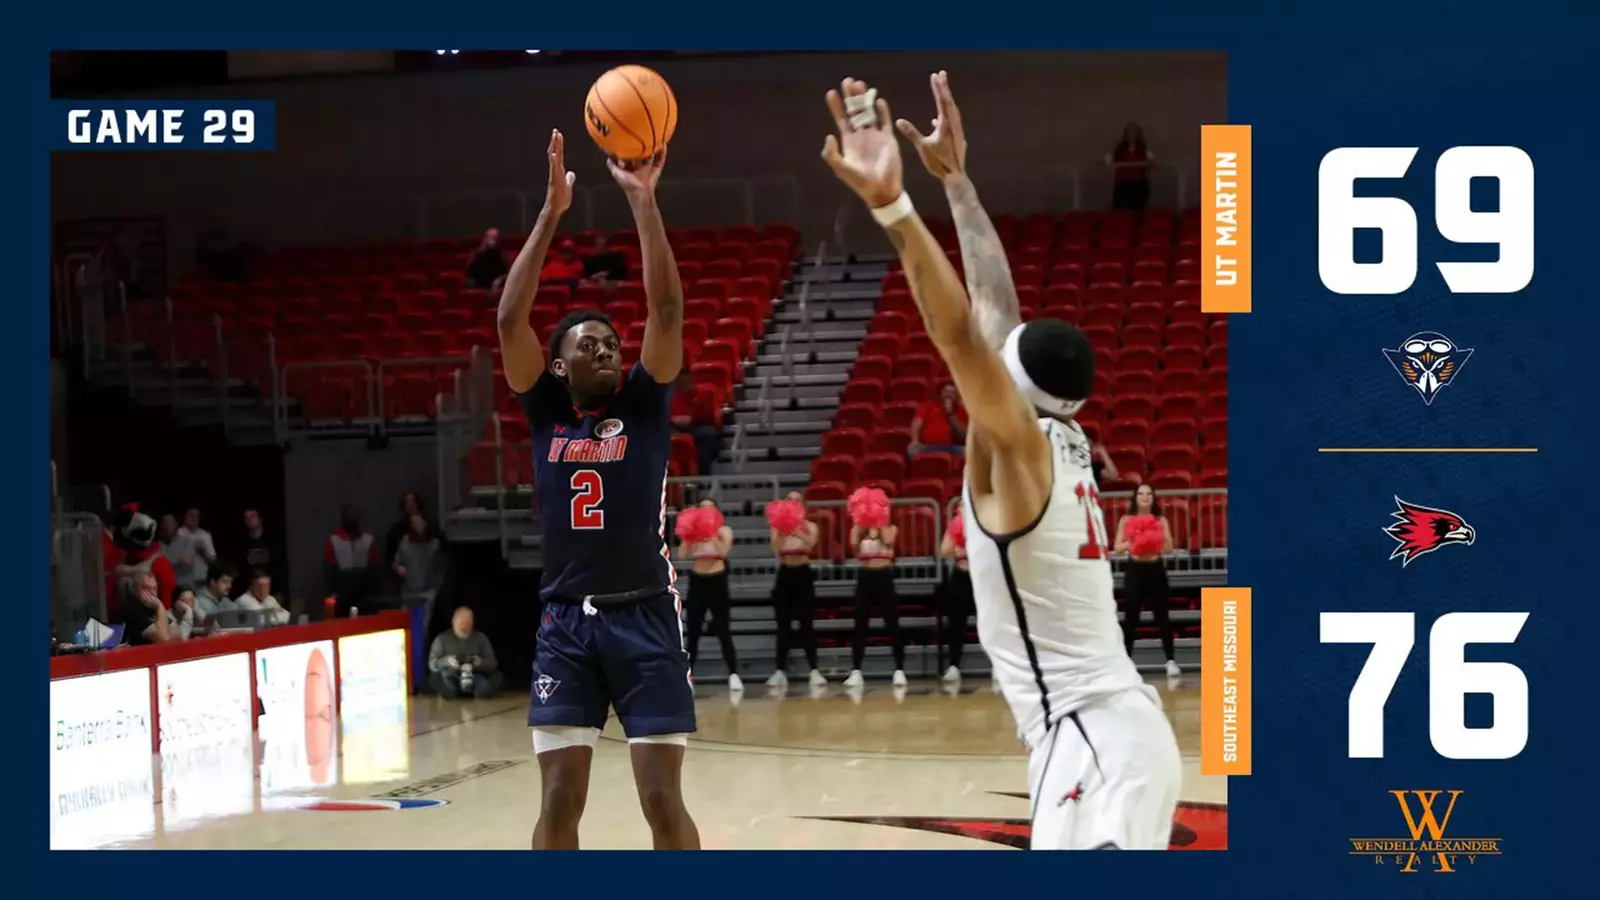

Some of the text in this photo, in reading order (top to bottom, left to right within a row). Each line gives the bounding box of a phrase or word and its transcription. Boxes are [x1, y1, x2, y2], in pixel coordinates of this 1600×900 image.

[548, 435, 628, 462] UT MARTIN
[570, 469, 604, 530] 2
